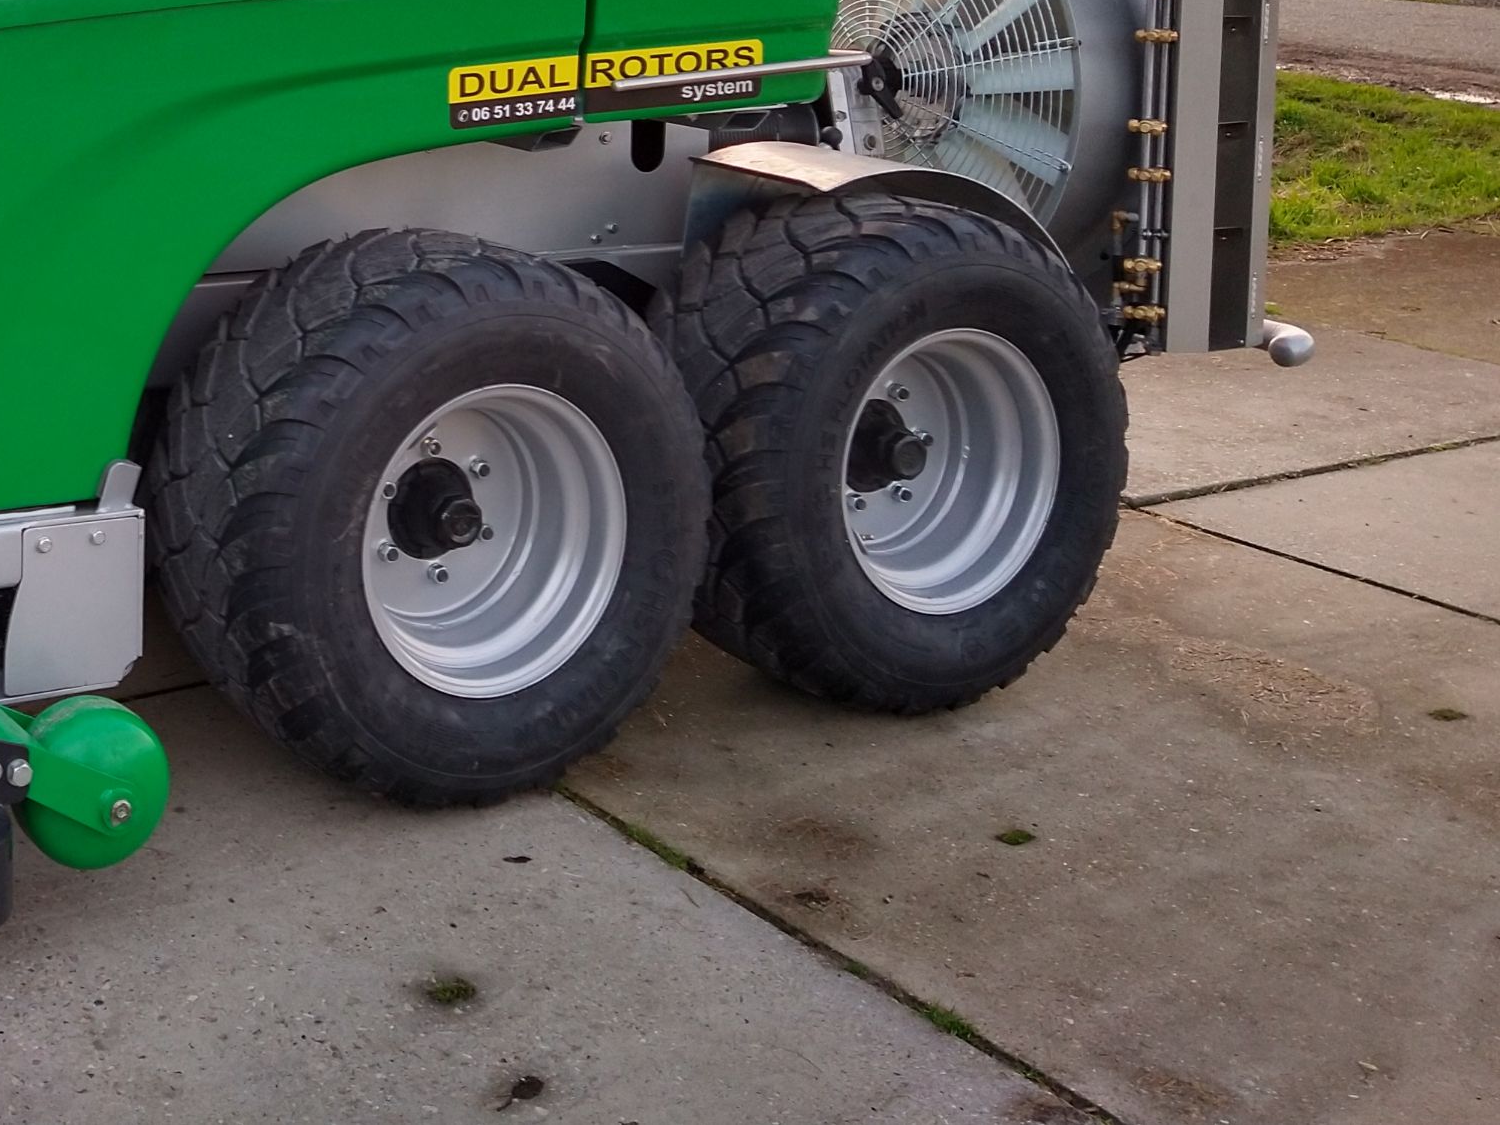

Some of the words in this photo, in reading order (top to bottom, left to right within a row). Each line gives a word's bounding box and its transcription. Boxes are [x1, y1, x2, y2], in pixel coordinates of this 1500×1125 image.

[459, 64, 570, 98] DUAL
[590, 46, 755, 84] ROTORS
[682, 79, 753, 101] system
[472, 106, 490, 121] 06
[493, 105, 511, 120] 51
[515, 102, 534, 118] 33
[537, 100, 555, 115] 74
[558, 97, 575, 112] 44
